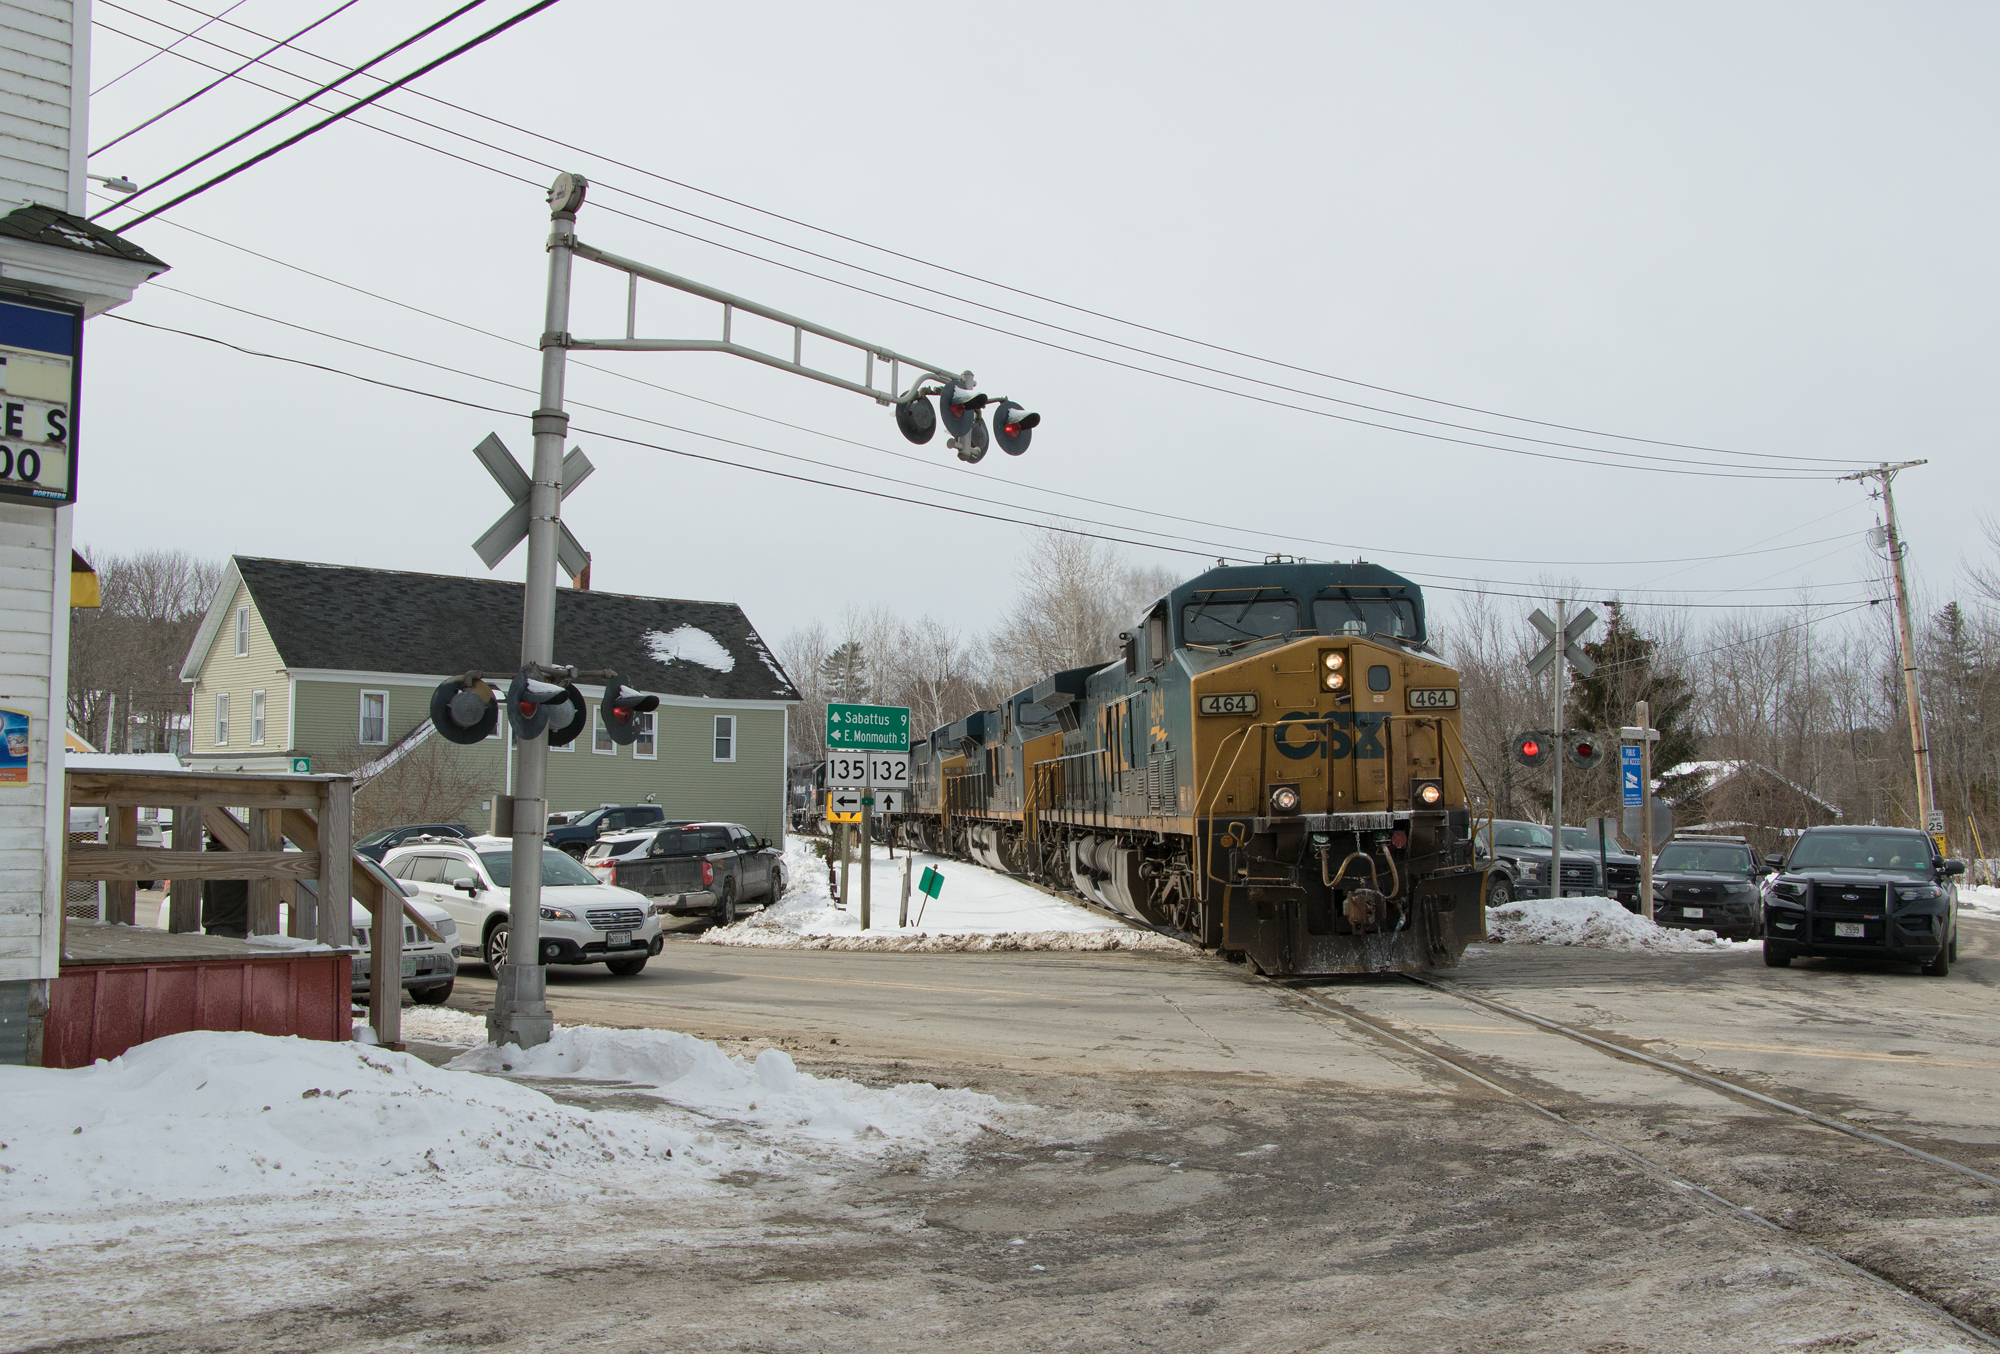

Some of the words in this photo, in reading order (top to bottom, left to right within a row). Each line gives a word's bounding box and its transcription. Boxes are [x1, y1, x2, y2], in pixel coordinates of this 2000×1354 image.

[32, 490, 67, 500] NORTHERN
[1209, 697, 1248, 712] 464
[1415, 690, 1448, 706] 464
[845, 711, 890, 726] Sabattus
[900, 714, 907, 726] 9
[853, 730, 898, 744] Monmouth
[900, 732, 907, 744] 3
[1273, 711, 1392, 760] CSX
[830, 759, 865, 780] 135
[872, 760, 907, 781] 132
[1929, 823, 1943, 831] 25
